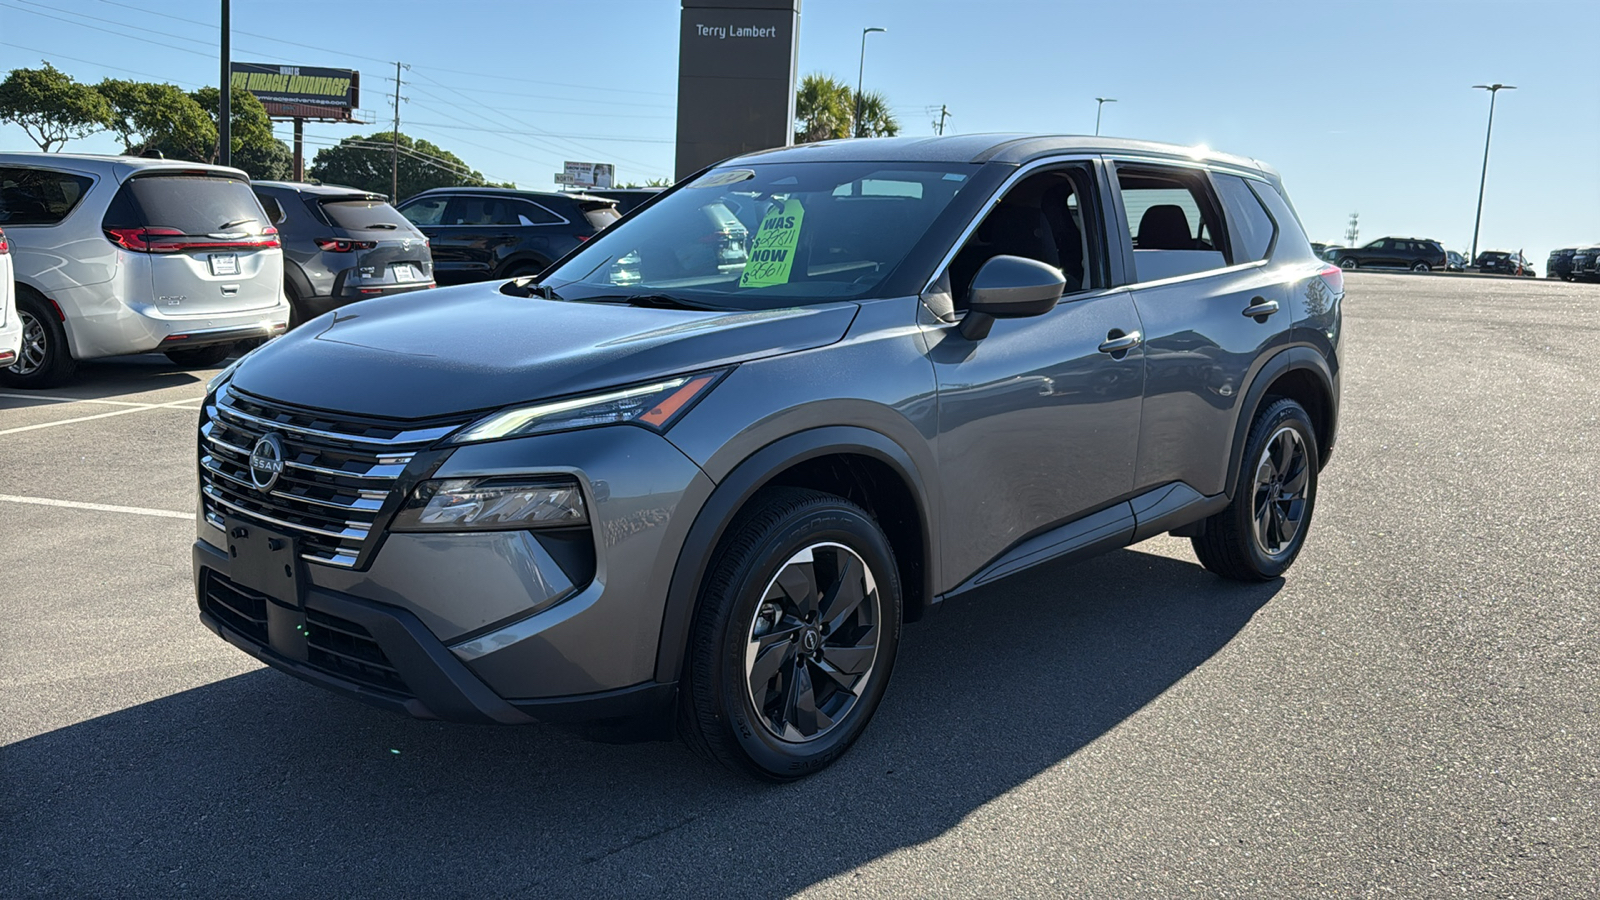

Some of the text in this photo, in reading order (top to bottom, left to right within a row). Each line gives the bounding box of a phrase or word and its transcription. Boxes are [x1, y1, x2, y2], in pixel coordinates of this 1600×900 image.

[696, 24, 776, 39] Terry Lambert
[231, 71, 350, 97] THE MIRACLE ADVANTAGE?
[256, 95, 347, 106] ymiracleadvantage.com
[763, 216, 795, 230] WAS
[751, 249, 788, 262] NOW
[253, 458, 281, 472] SSAN
